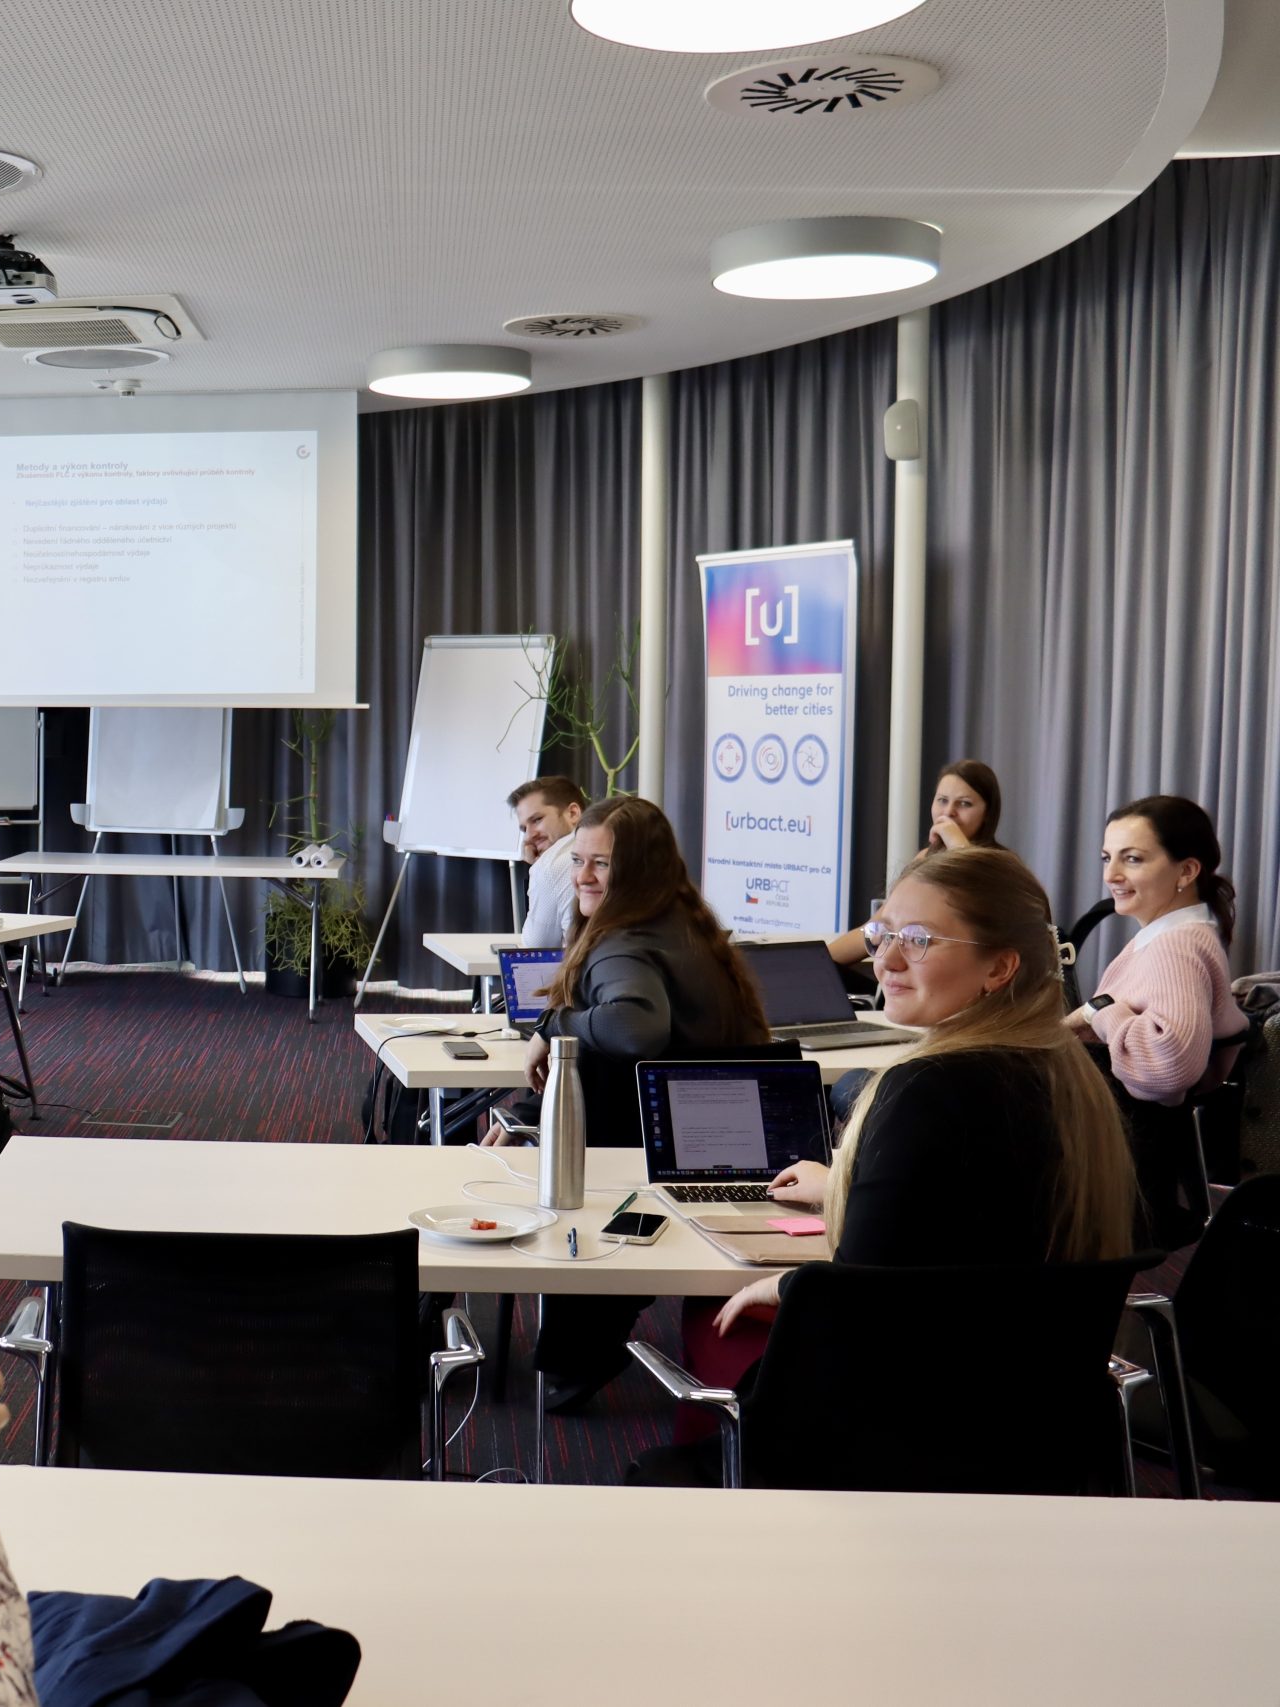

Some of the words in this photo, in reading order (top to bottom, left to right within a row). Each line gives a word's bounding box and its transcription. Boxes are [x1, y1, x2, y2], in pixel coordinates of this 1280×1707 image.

[16, 463, 49, 473] Metody
[60, 461, 88, 473] výkon
[90, 462, 129, 472] kontroly
[99, 499, 113, 507] pro
[728, 685, 768, 699] Driving
[772, 683, 813, 699] change
[816, 683, 834, 695] for
[765, 703, 799, 716] better
[802, 702, 833, 715] cities
[783, 863, 809, 872] URBACT
[809, 866, 820, 874] pro
[746, 877, 790, 893] URBACT
